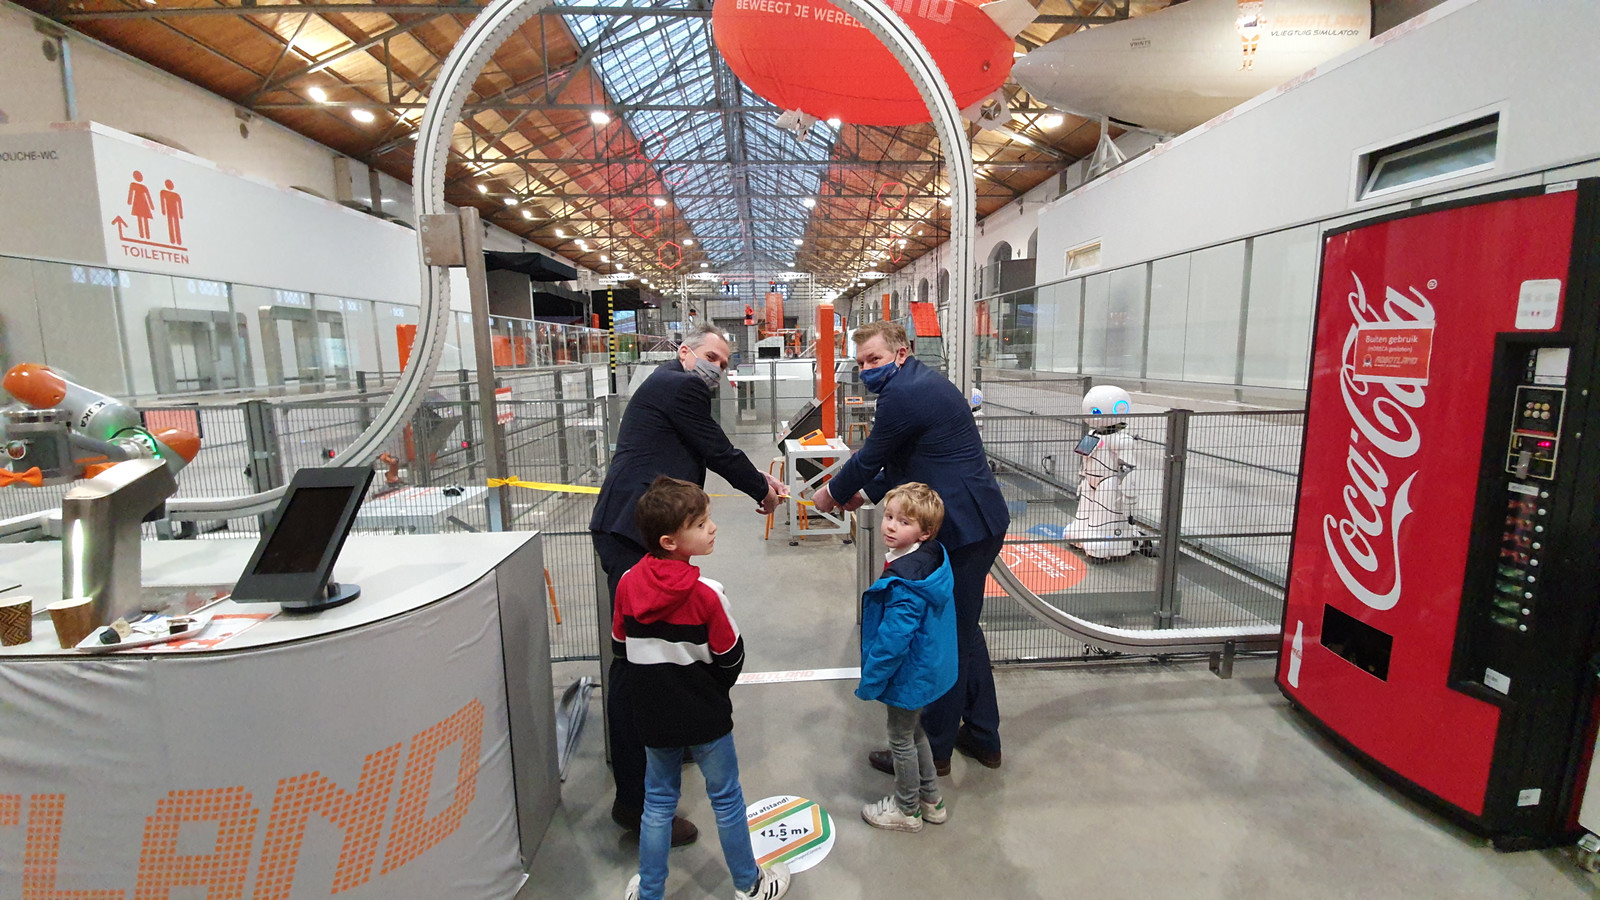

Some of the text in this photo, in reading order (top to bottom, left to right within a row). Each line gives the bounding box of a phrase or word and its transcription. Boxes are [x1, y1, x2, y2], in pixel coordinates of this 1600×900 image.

[736, 0, 866, 28] BEWEEGT JE WEREL
[1271, 29, 1311, 37] VLIEGTUIG
[0, 150, 59, 162] OUCHE-WC.
[121, 244, 189, 264] TOILETTEN
[1365, 334, 1418, 345] Buiten gebruik
[80, 401, 106, 427] KUKA
[747, 797, 790, 819] ou afstand!
[768, 828, 787, 838] 1,5
